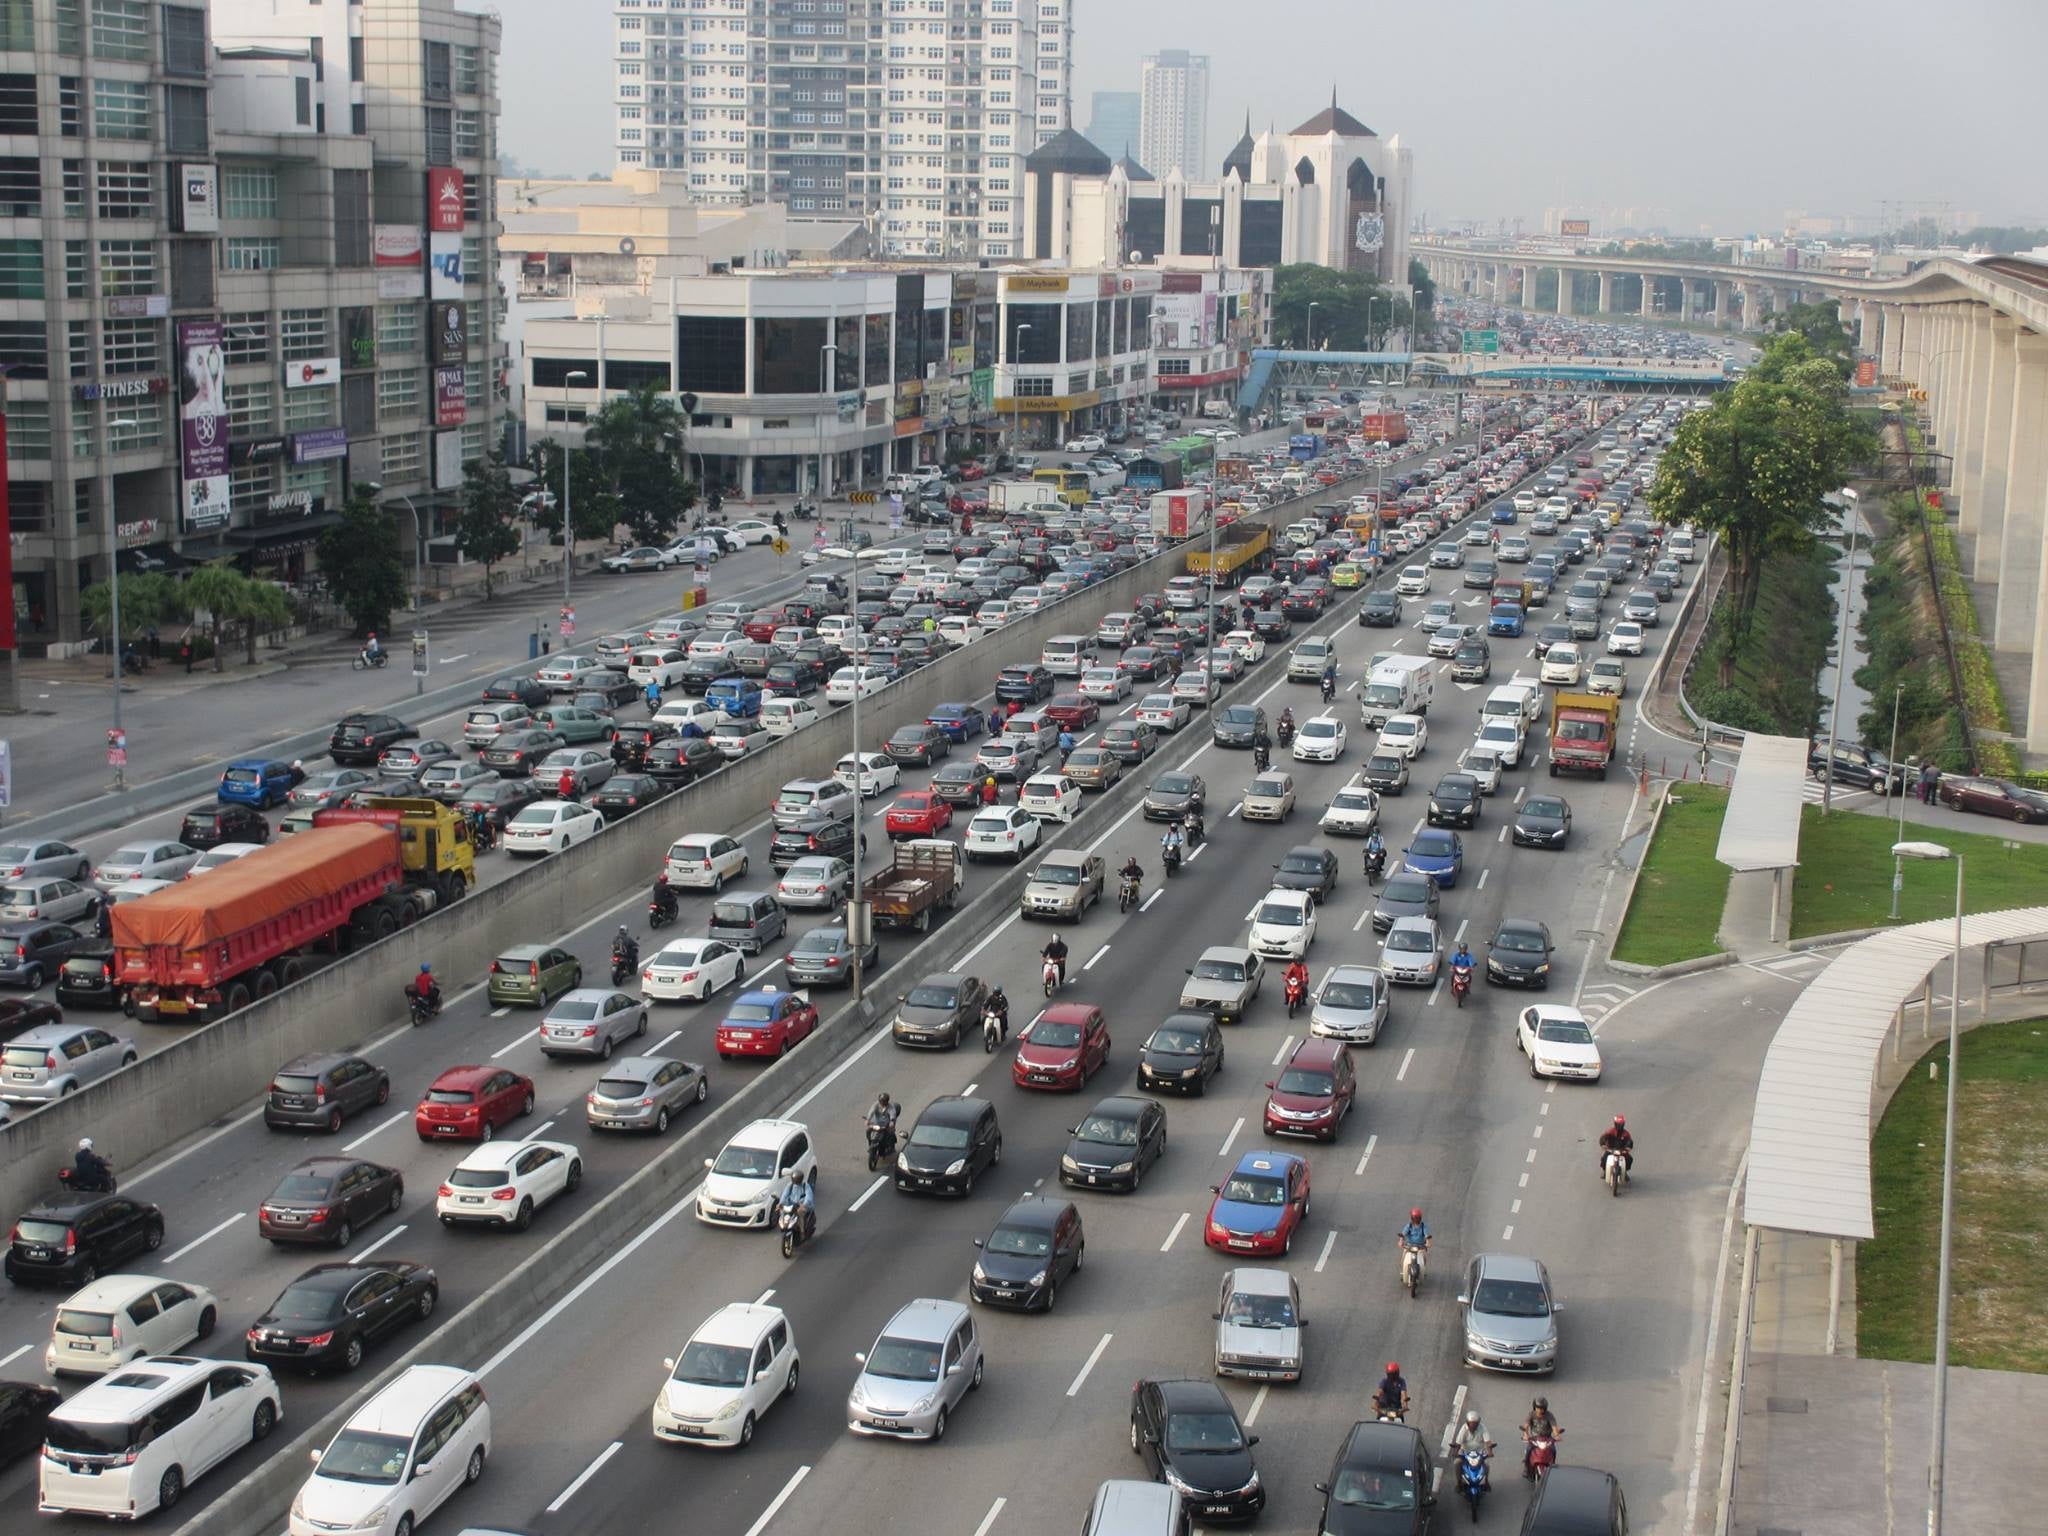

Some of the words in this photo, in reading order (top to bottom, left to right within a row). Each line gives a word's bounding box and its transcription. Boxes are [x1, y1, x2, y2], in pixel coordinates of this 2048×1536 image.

[1027, 279, 1060, 288] Maybank
[100, 380, 149, 398] FITNESS
[1026, 401, 1059, 410] Maybank
